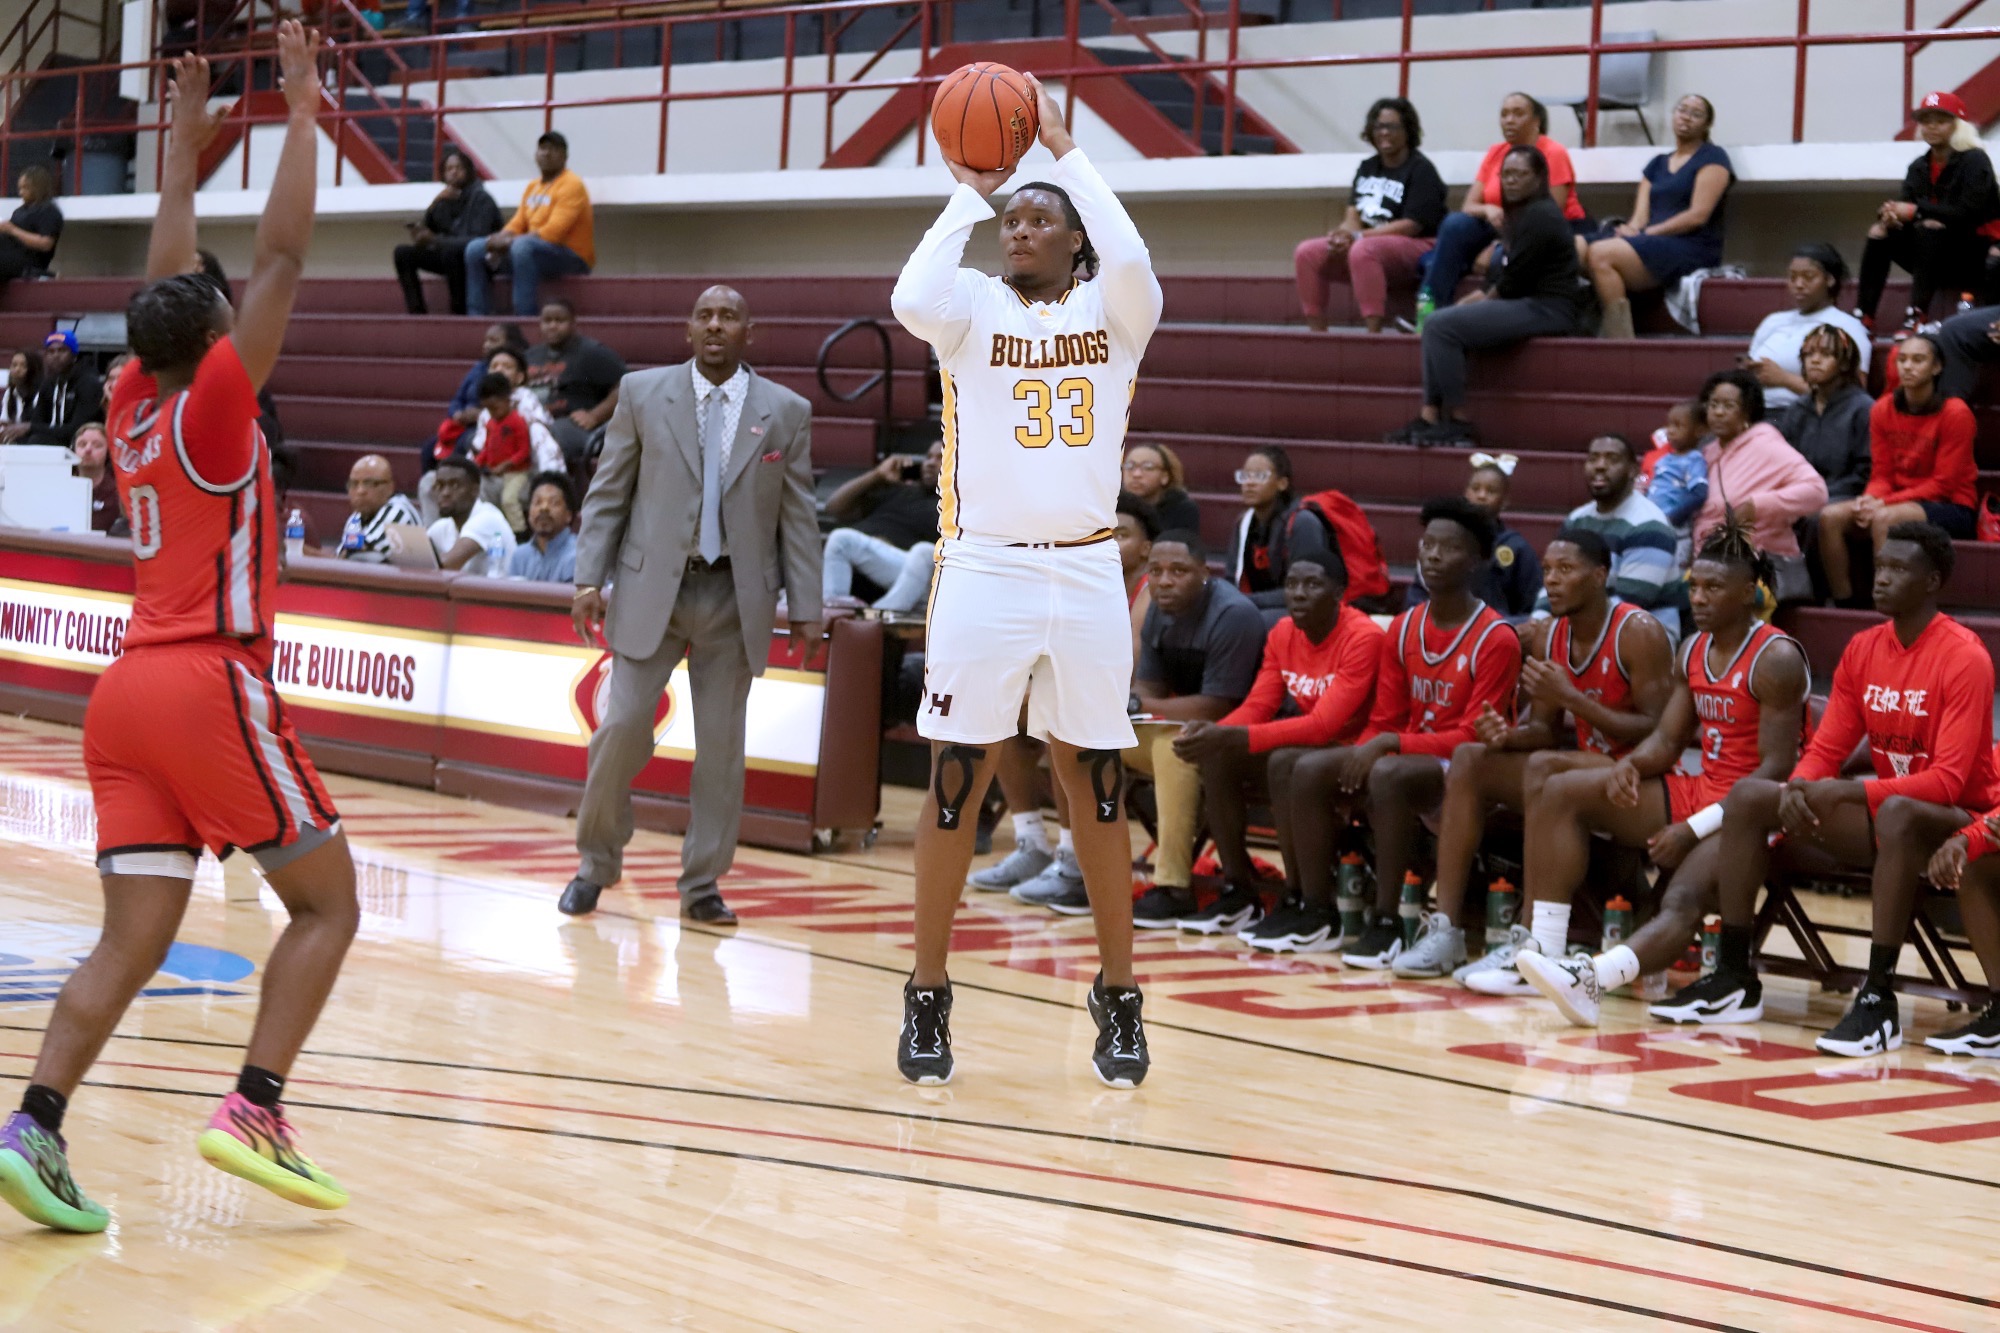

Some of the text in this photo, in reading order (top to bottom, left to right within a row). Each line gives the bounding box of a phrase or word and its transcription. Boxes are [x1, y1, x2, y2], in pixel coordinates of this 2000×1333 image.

[990, 329, 1109, 369] BULLDOGS
[1013, 377, 1094, 448] 33
[129, 484, 162, 561] 0
[0, 602, 62, 647] MUNITY
[307, 644, 416, 702] BULLDOGS
[928, 693, 953, 717] H
[1863, 684, 1929, 716] FEAR THE
